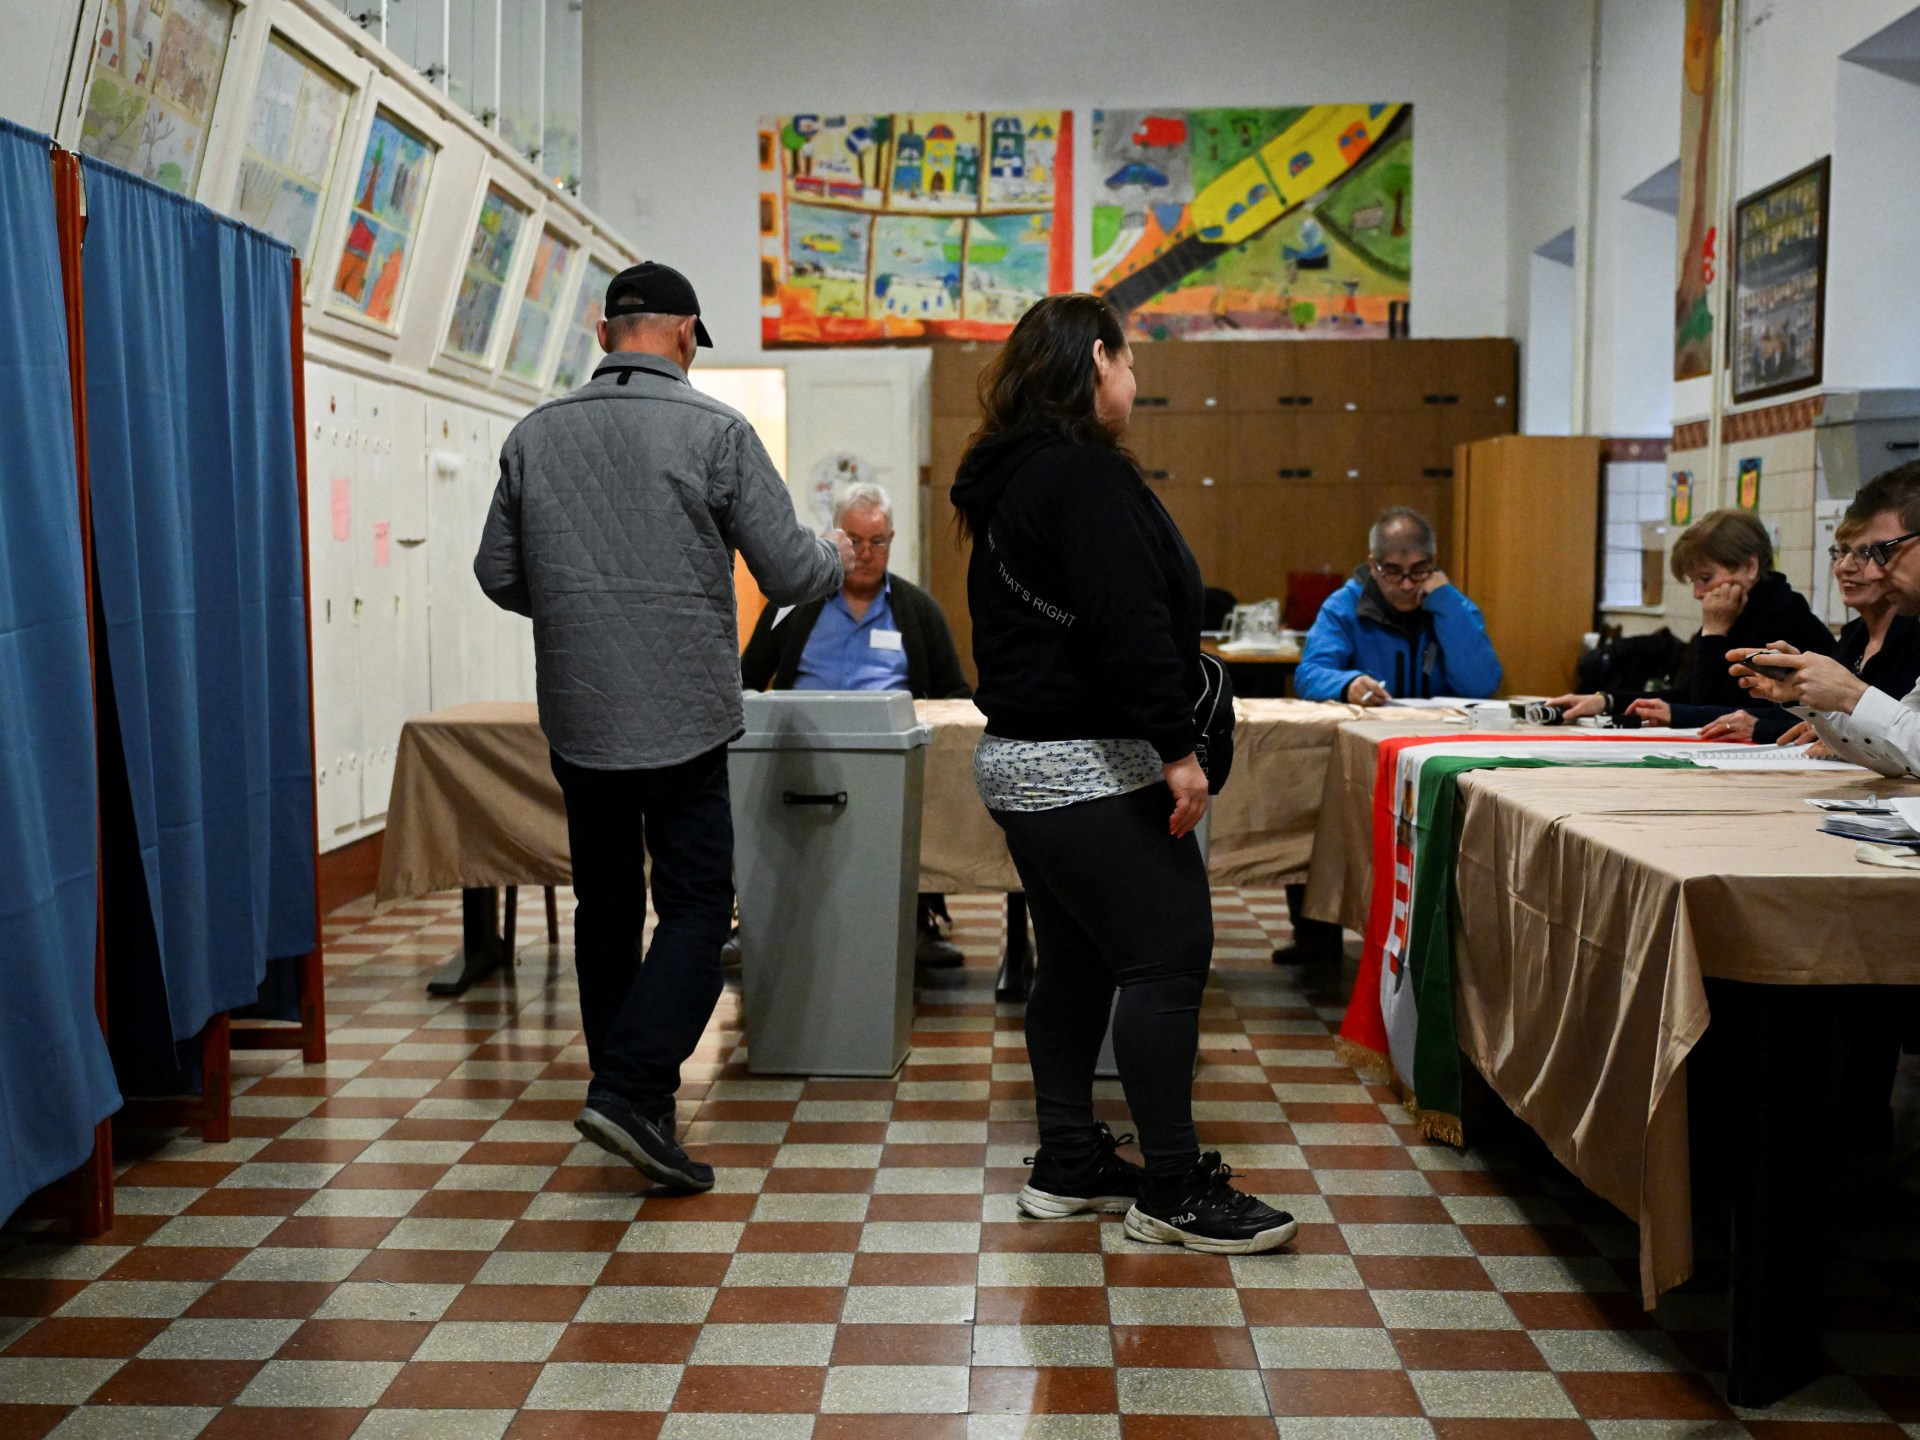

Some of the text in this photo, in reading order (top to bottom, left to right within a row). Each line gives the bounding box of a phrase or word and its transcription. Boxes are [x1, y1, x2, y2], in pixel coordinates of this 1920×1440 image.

[998, 561, 1078, 627] THAT'S RIGHT
[1194, 743, 1208, 763] AT'S
[1169, 1212, 1197, 1226] FILA
